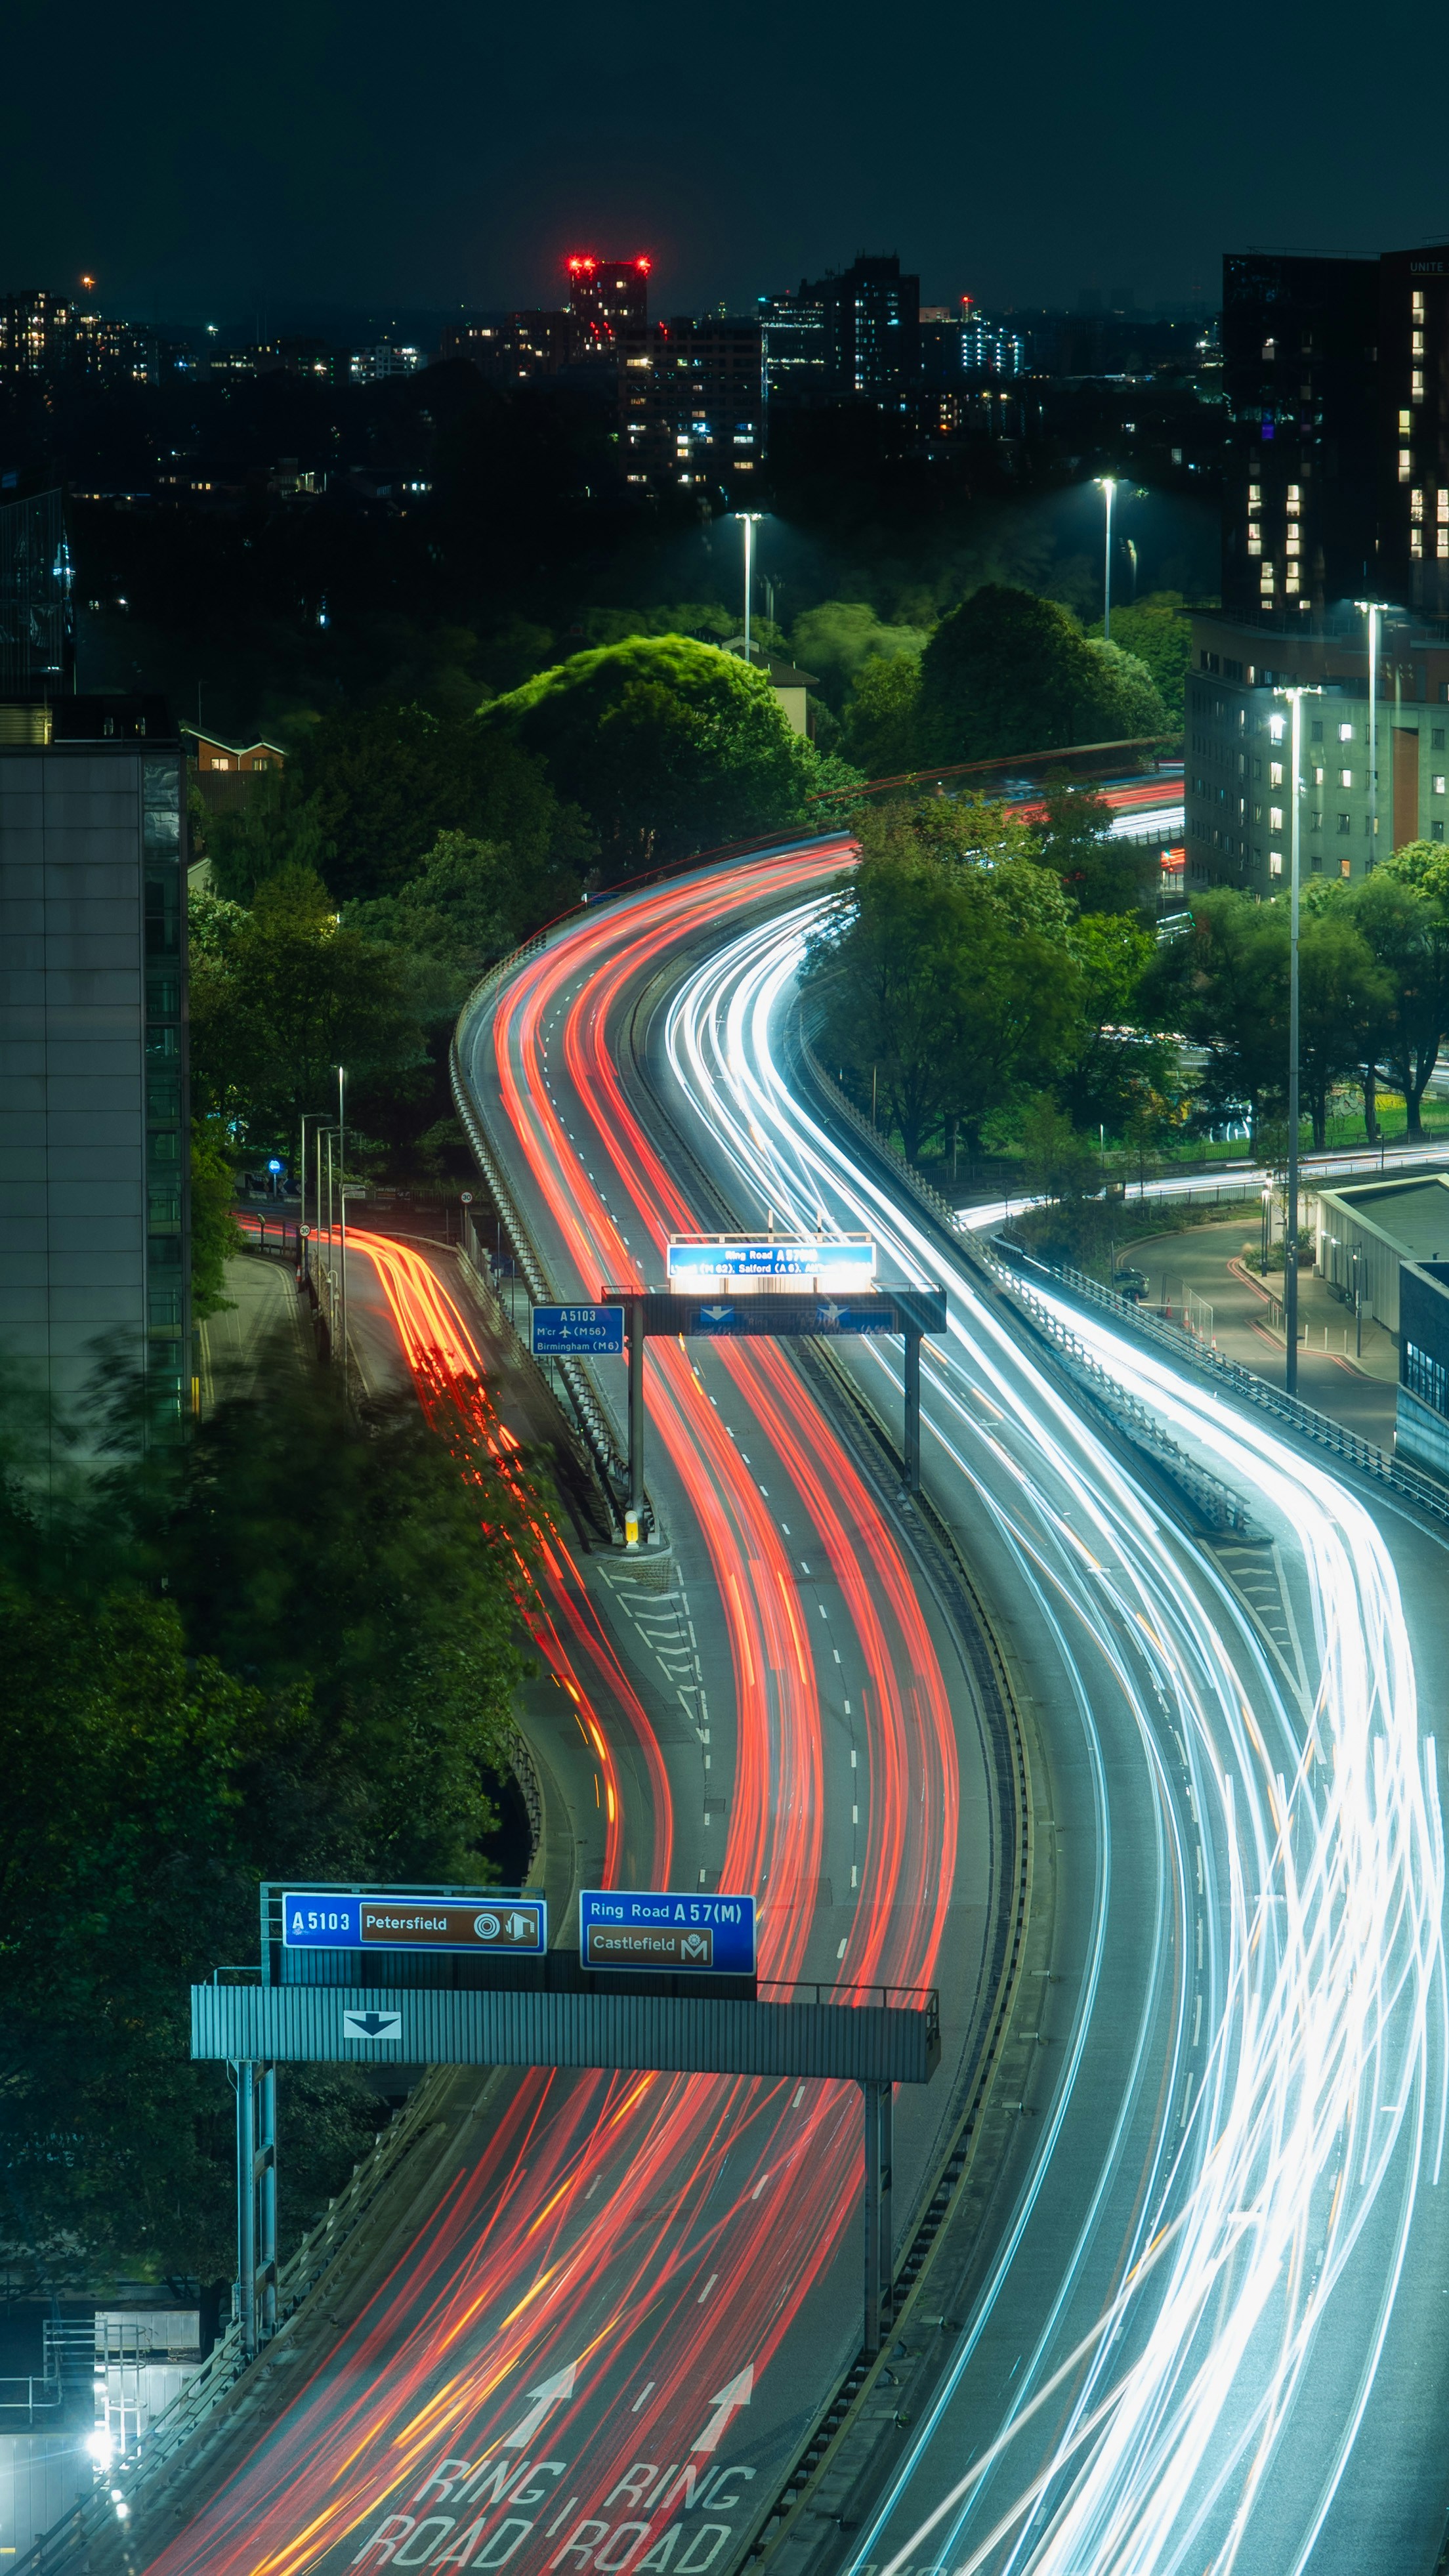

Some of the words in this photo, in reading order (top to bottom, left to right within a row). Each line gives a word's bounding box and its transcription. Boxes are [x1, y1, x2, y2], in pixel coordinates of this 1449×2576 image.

[1410, 262, 1444, 272] UNITE
[749, 1250, 772, 1260] Road
[738, 1263, 771, 1273] Salford
[537, 1342, 590, 1352] Birmingham
[591, 1903, 624, 1919] Ring
[631, 1904, 670, 1918] Road
[366, 1914, 448, 1931] Petersfield
[593, 1935, 675, 1951] Castlefield
[412, 2459, 567, 2504] RING
[603, 2462, 757, 2510] RING
[350, 2514, 534, 2568] ROAD
[549, 2519, 732, 2574] ROAD
